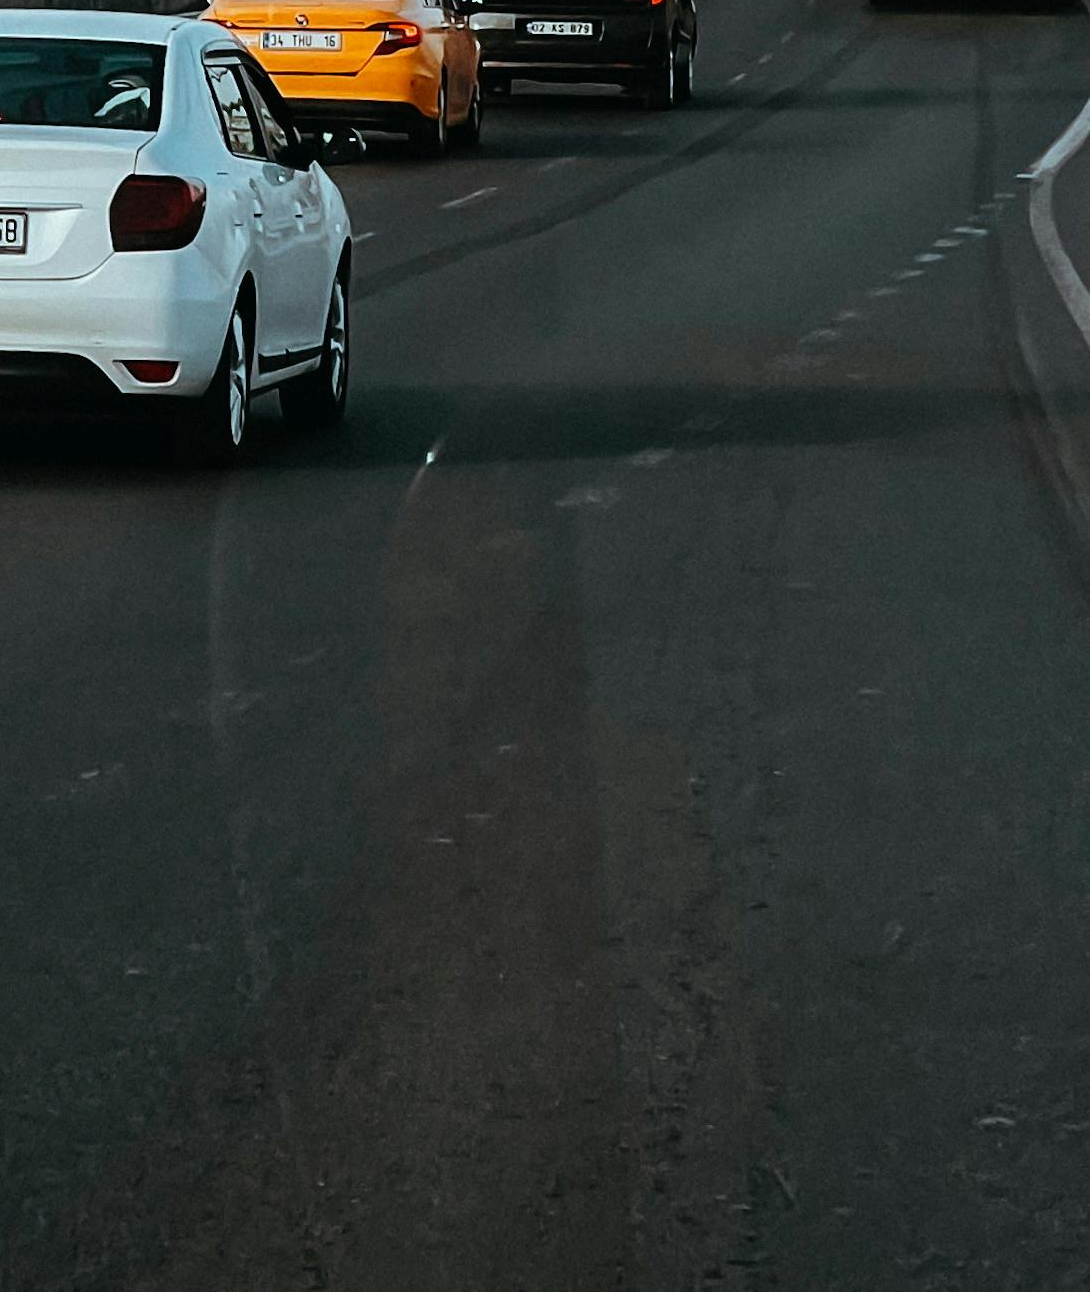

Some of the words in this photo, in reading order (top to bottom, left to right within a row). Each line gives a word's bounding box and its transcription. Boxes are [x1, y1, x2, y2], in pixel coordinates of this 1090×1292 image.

[271, 34, 284, 47] 34
[292, 34, 313, 47] THU
[324, 35, 336, 48] 16
